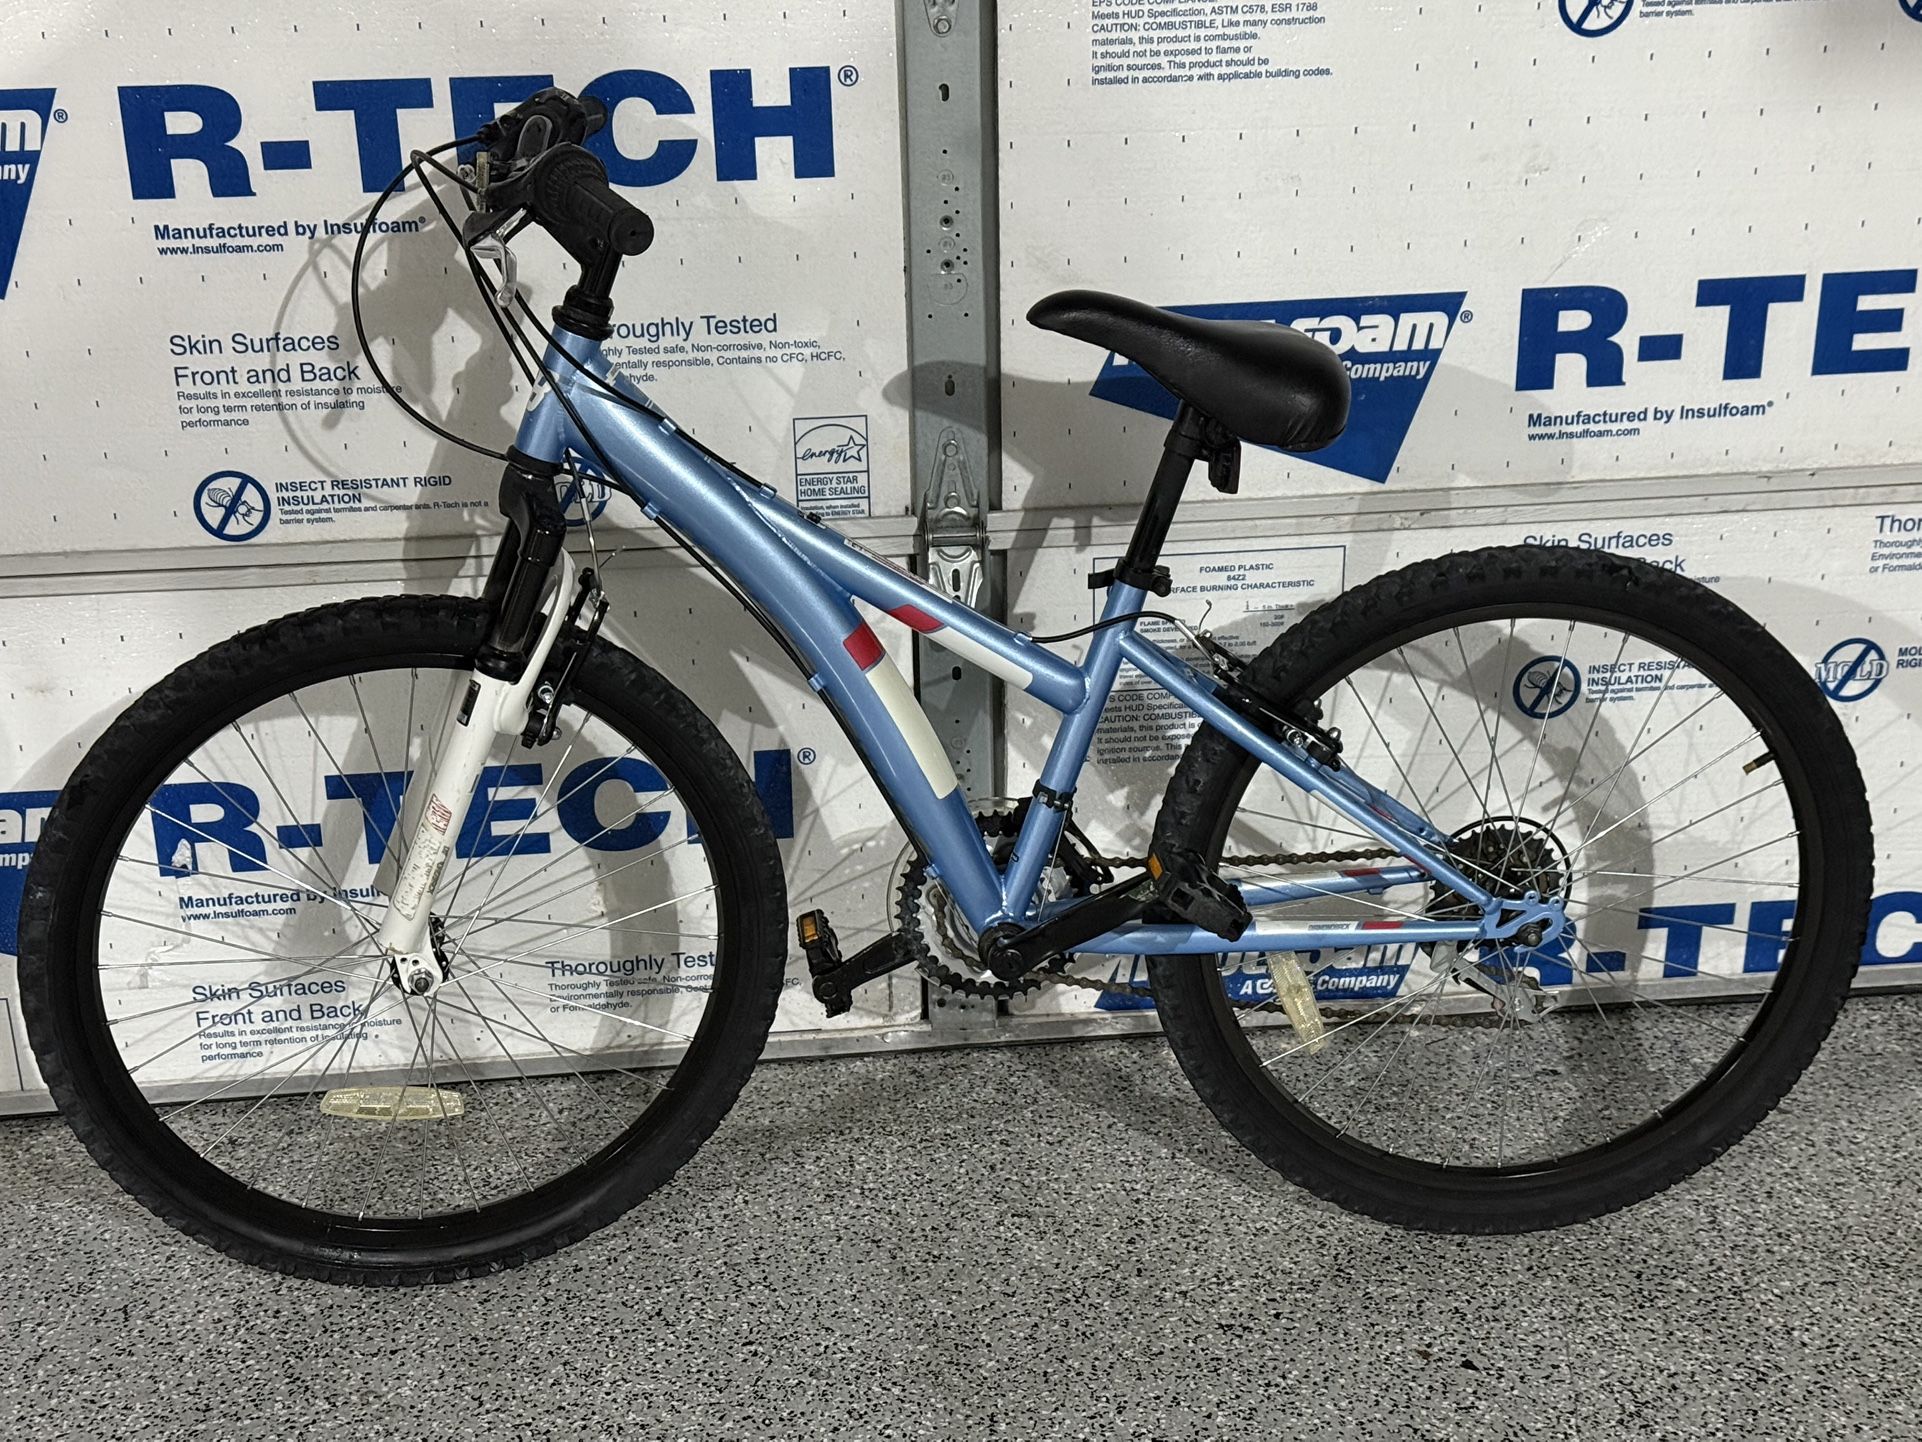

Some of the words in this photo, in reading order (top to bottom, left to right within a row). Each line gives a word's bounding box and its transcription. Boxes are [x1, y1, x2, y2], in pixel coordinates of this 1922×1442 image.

[1092, 10, 1120, 20] Meets
[1122, 9, 1145, 19] HUD
[1147, 7, 1208, 20] Specification,
[1210, 5, 1239, 16] ASTM
[1241, 5, 1268, 15] C578,
[1271, 3, 1292, 13] ESR
[1295, 2, 1318, 12] 1788
[1092, 22, 1141, 33] CAUTION:
[1143, 19, 1219, 31] COMBUSTIBLE,
[1221, 18, 1240, 28] Like
[1243, 19, 1268, 29] many
[1270, 15, 1325, 26] construction
[1092, 36, 1135, 46] materials,
[1138, 35, 1154, 44] this
[1157, 33, 1191, 46] product
[1193, 33, 1201, 42] is
[1204, 31, 1260, 42] combustible.
[1092, 50, 1098, 59] It
[1100, 48, 1130, 59] should
[1132, 48, 1147, 58] not
[1150, 47, 1161, 57] be
[1163, 45, 1202, 58] exposed
[1204, 45, 1213, 55] to
[1216, 44, 1240, 54] flame
[1243, 45, 1252, 53] or
[1092, 62, 1124, 74] ignition
[1126, 62, 1165, 71] sources.
[1167, 59, 1186, 69] This
[1188, 58, 1223, 71] product
[1225, 57, 1255, 67] should
[1258, 56, 1269, 66] be
[1092, 74, 1129, 85] installed
[1131, 74, 1139, 84] in
[1142, 73, 1194, 83] accordance
[1196, 71, 1215, 81] with
[1217, 69, 1263, 83] applicable
[1265, 68, 1300, 80] building
[1303, 67, 1332, 77] codes.
[154, 219, 288, 240] Manufactured
[294, 218, 318, 240] by
[157, 241, 284, 256] www.Insulfoam.com
[700, 314, 777, 336] Tested
[170, 335, 223, 355] Skin
[232, 332, 340, 353] Surfaces
[626, 345, 660, 355] Tested
[663, 344, 688, 355] safe,
[691, 342, 766, 353] Non-corrosive,
[769, 339, 821, 350] Non-toxic,
[651, 356, 714, 369] responsible,
[716, 354, 762, 365] Contains
[765, 355, 778, 363] no
[781, 352, 807, 364] CFC,
[810, 351, 845, 362] HCFC,
[174, 365, 238, 387] Front
[247, 363, 291, 384] and
[299, 361, 360, 382] Back
[177, 390, 218, 401] Results
[221, 390, 231, 399] in
[234, 388, 282, 399] excellent
[285, 387, 340, 397] resistance
[343, 386, 354, 395] to
[179, 405, 194, 415] for
[196, 404, 219, 416] long
[222, 403, 247, 413] term
[250, 401, 297, 412] retention
[301, 401, 311, 411] of
[314, 399, 365, 411] insulating
[181, 418, 249, 430] performance
[1527, 407, 1650, 428] Manufactured
[1654, 407, 1674, 425] by
[1527, 428, 1640, 441] www.Insulfoam.com
[275, 480, 326, 493] INSECT
[331, 477, 409, 491] RESISTANT
[414, 475, 452, 488] RIGID
[799, 476, 834, 487] ENERGY
[836, 475, 858, 485] STAR
[799, 487, 827, 497] HOME
[828, 485, 866, 496] SEALING
[277, 493, 362, 507] INSULATION
[1577, 531, 1674, 550] Surfaces
[1199, 564, 1236, 574] FOAMED
[1238, 562, 1274, 572] PLASTIC
[1199, 583, 1239, 592] BURNING
[1240, 579, 1315, 590] CHARACTERISTIC
[1588, 663, 1634, 675] INSECT
[1587, 673, 1663, 687] INSULATION
[1118, 693, 1145, 703] CODE
[1124, 703, 1145, 712] HUD
[1138, 724, 1154, 732] this
[1156, 722, 1186, 733] product
[1105, 735, 1132, 744] should
[1134, 735, 1148, 743] not
[1149, 733, 1160, 741] be
[179, 892, 300, 910] Manufactured
[181, 906, 297, 923] www.Insulfoam.com
[545, 954, 665, 978] Thoroughly
[549, 980, 601, 991] Thoroughly
[1317, 973, 1400, 991] Company
[191, 984, 241, 1002] Skin
[248, 979, 346, 999] Surfaces
[195, 1006, 254, 1028] Front
[261, 1003, 301, 1023] and
[309, 999, 364, 1020] Back
[199, 1029, 235, 1040] Results
[238, 1028, 247, 1037] in
[249, 1024, 293, 1036] excellent
[199, 1041, 213, 1051] for
[215, 1040, 237, 1051] long
[239, 1039, 262, 1048] term
[264, 1035, 307, 1046] retention
[310, 1034, 320, 1043] of
[201, 1051, 263, 1064] performance
